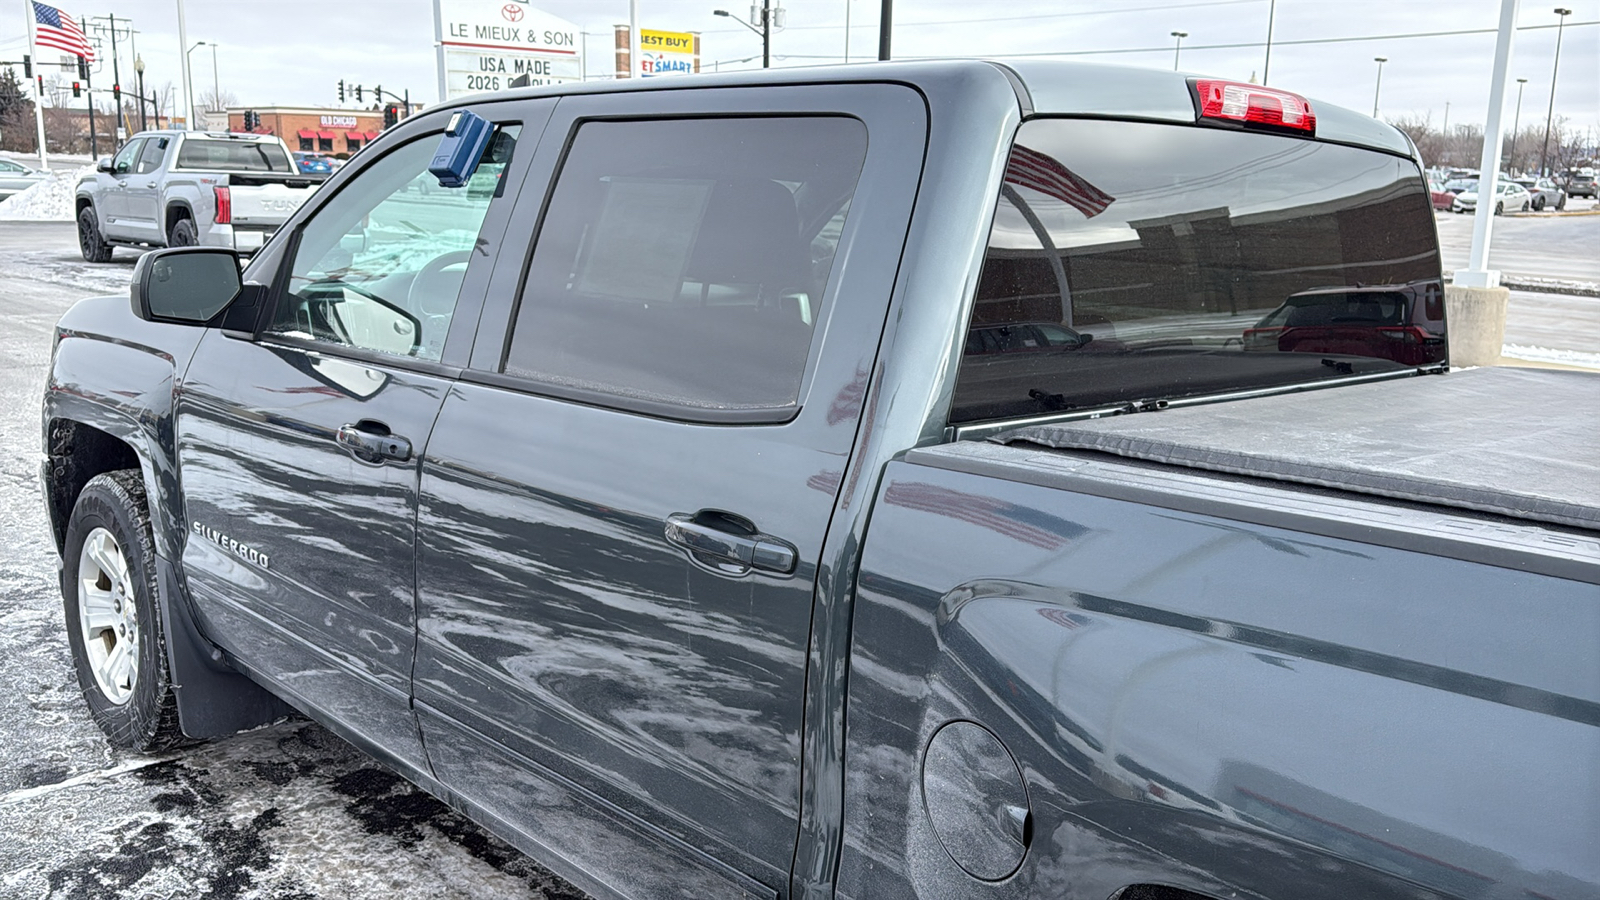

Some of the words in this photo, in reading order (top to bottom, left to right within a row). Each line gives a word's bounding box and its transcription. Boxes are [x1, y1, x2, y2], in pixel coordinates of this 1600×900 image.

[450, 23, 469, 38] LE
[475, 25, 521, 42] MIEUX
[527, 29, 537, 43] &
[544, 31, 574, 47] SON
[666, 37, 689, 48] BUY
[479, 56, 506, 73] USA
[514, 59, 551, 76] MADE
[641, 60, 692, 74] ETSMART
[467, 75, 500, 91] 2026
[193, 520, 269, 569] SILVERADO
